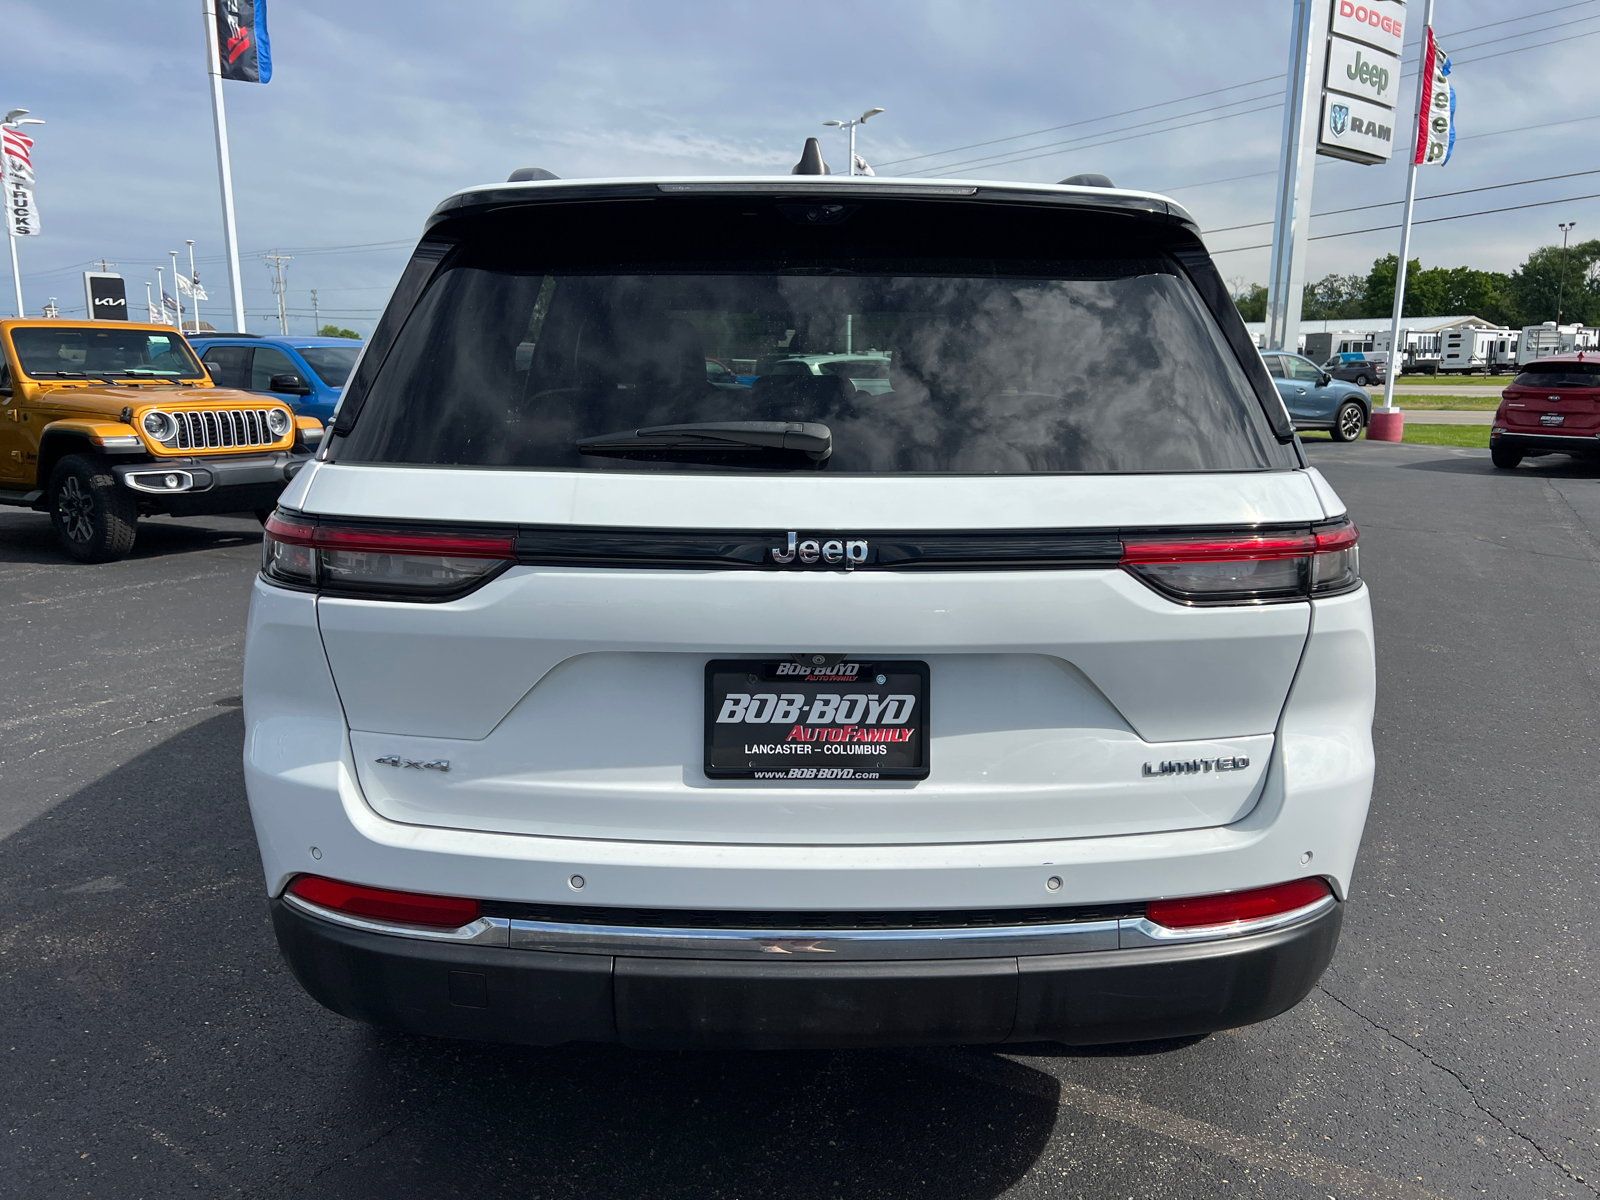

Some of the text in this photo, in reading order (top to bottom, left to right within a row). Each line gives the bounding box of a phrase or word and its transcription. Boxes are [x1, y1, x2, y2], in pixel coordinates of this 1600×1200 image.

[1340, 0, 1402, 38] DODGE
[1346, 50, 1389, 95] Jeep
[1350, 116, 1392, 142] RAM
[11, 182, 31, 235] TRUCKS
[771, 531, 868, 571] Jeep
[744, 744, 812, 754] LANCASTER
[823, 744, 887, 755] COLUMBUS
[1142, 755, 1250, 777] LIMITED
